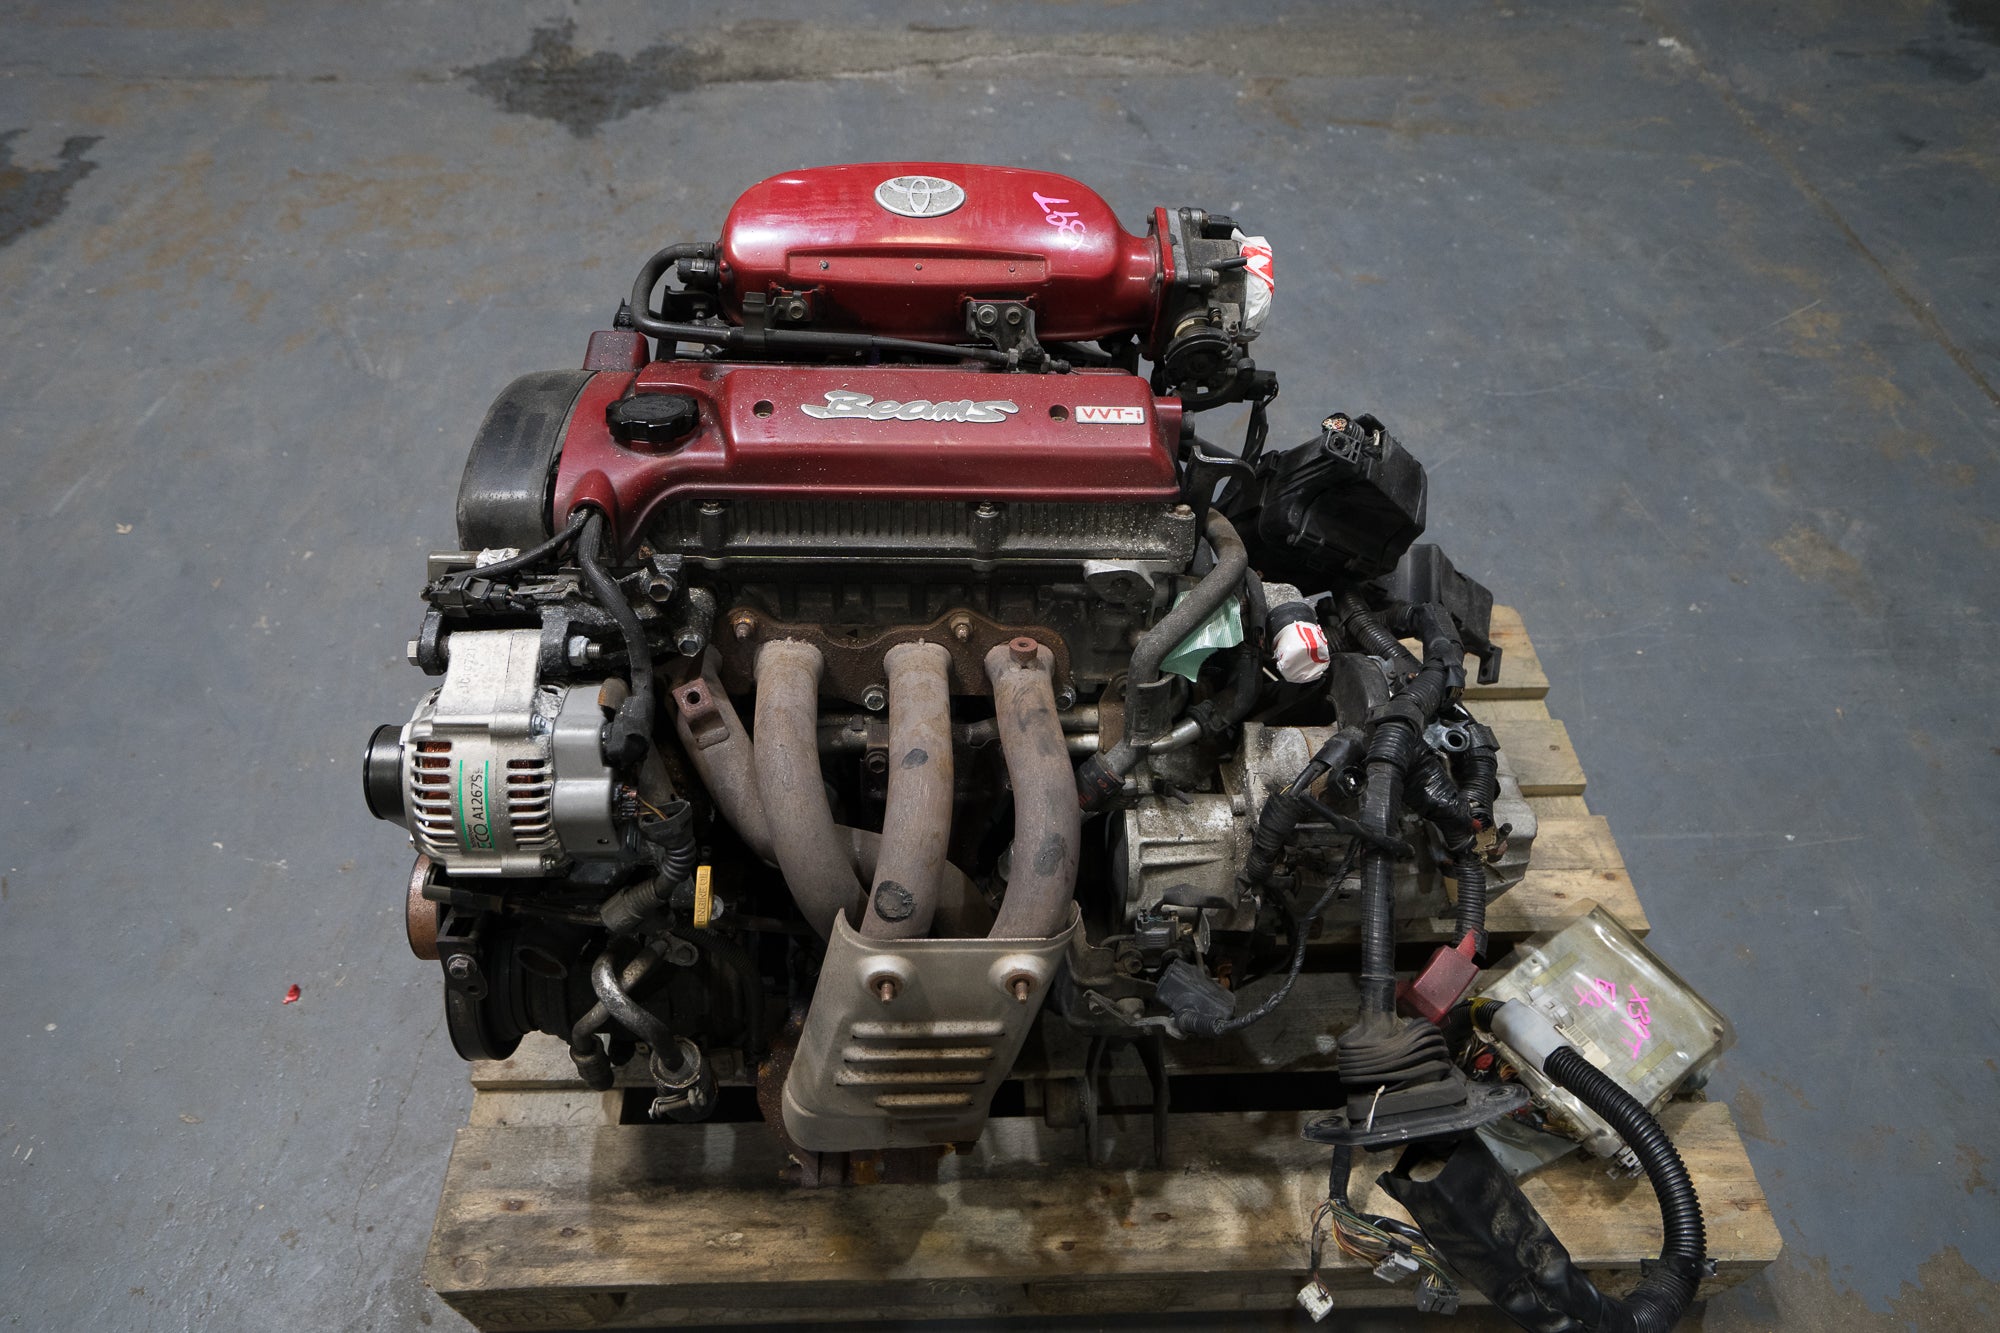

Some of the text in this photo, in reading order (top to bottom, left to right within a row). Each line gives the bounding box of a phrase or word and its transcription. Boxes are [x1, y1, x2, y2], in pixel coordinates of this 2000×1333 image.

[800, 389, 1020, 423] Beams
[1081, 408, 1142, 420] VVT-i
[1620, 984, 1652, 1060] X39T
